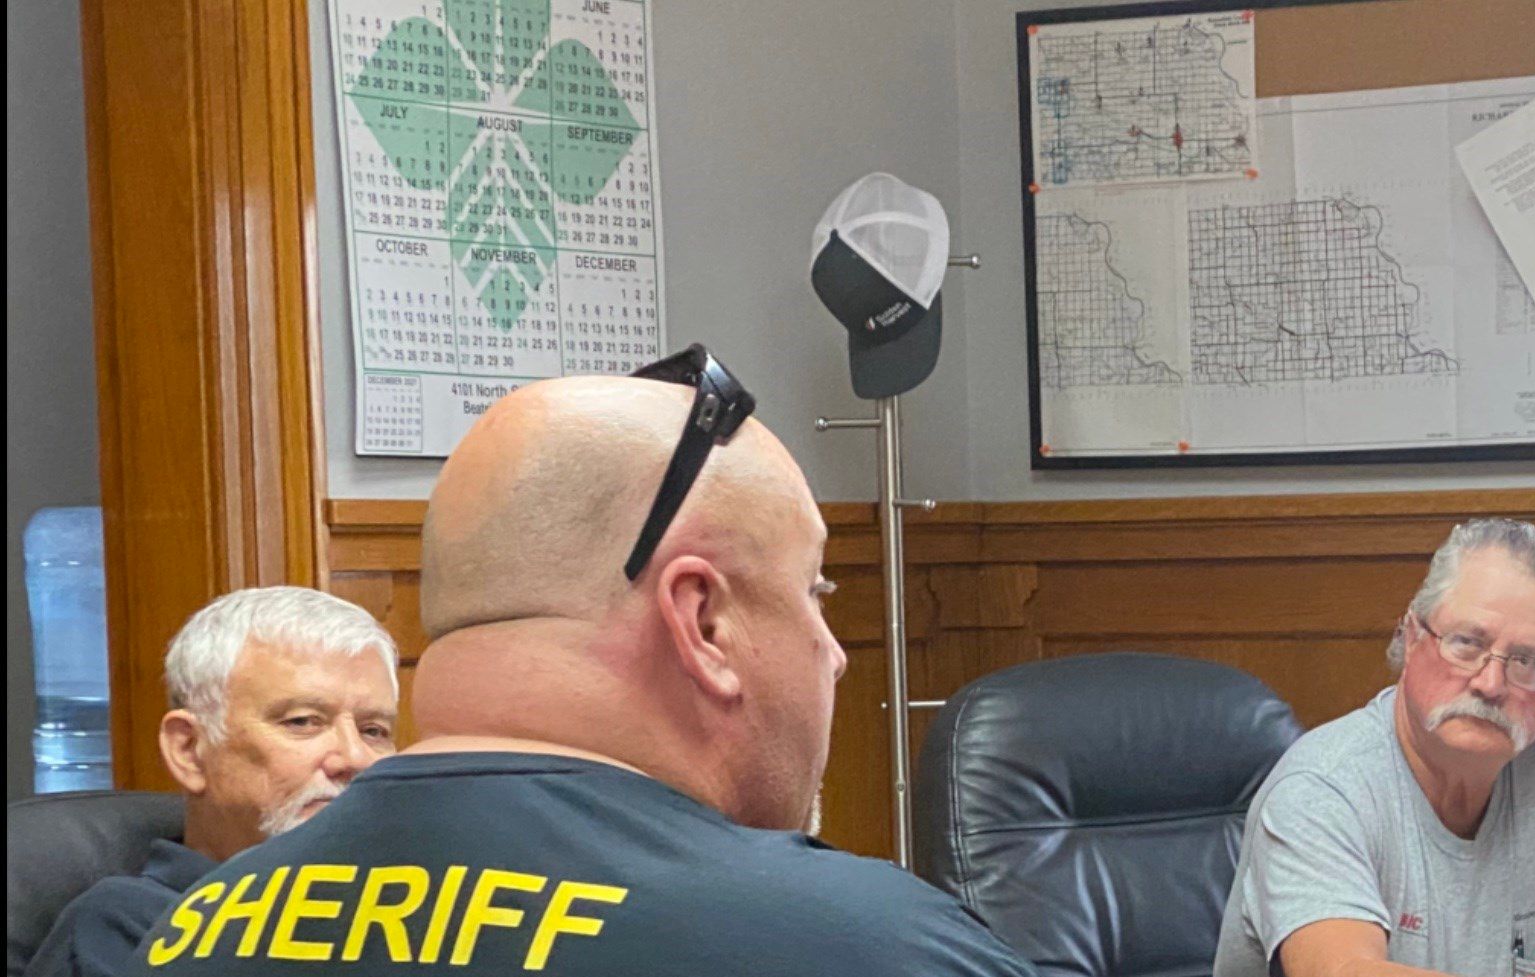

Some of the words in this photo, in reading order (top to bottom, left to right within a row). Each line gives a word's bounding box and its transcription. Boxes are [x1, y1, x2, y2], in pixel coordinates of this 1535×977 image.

[380, 104, 408, 119] JULY
[477, 116, 522, 132] AUGUST
[567, 126, 633, 145] SEPTEMBER
[376, 239, 428, 256] OCTOBER
[471, 248, 536, 264] NOVEMBER
[576, 256, 637, 272] DECEMBER
[452, 382, 473, 397] 4101
[476, 384, 507, 398] North
[463, 400, 491, 416] Beatr
[148, 864, 628, 970] SHERIFF
